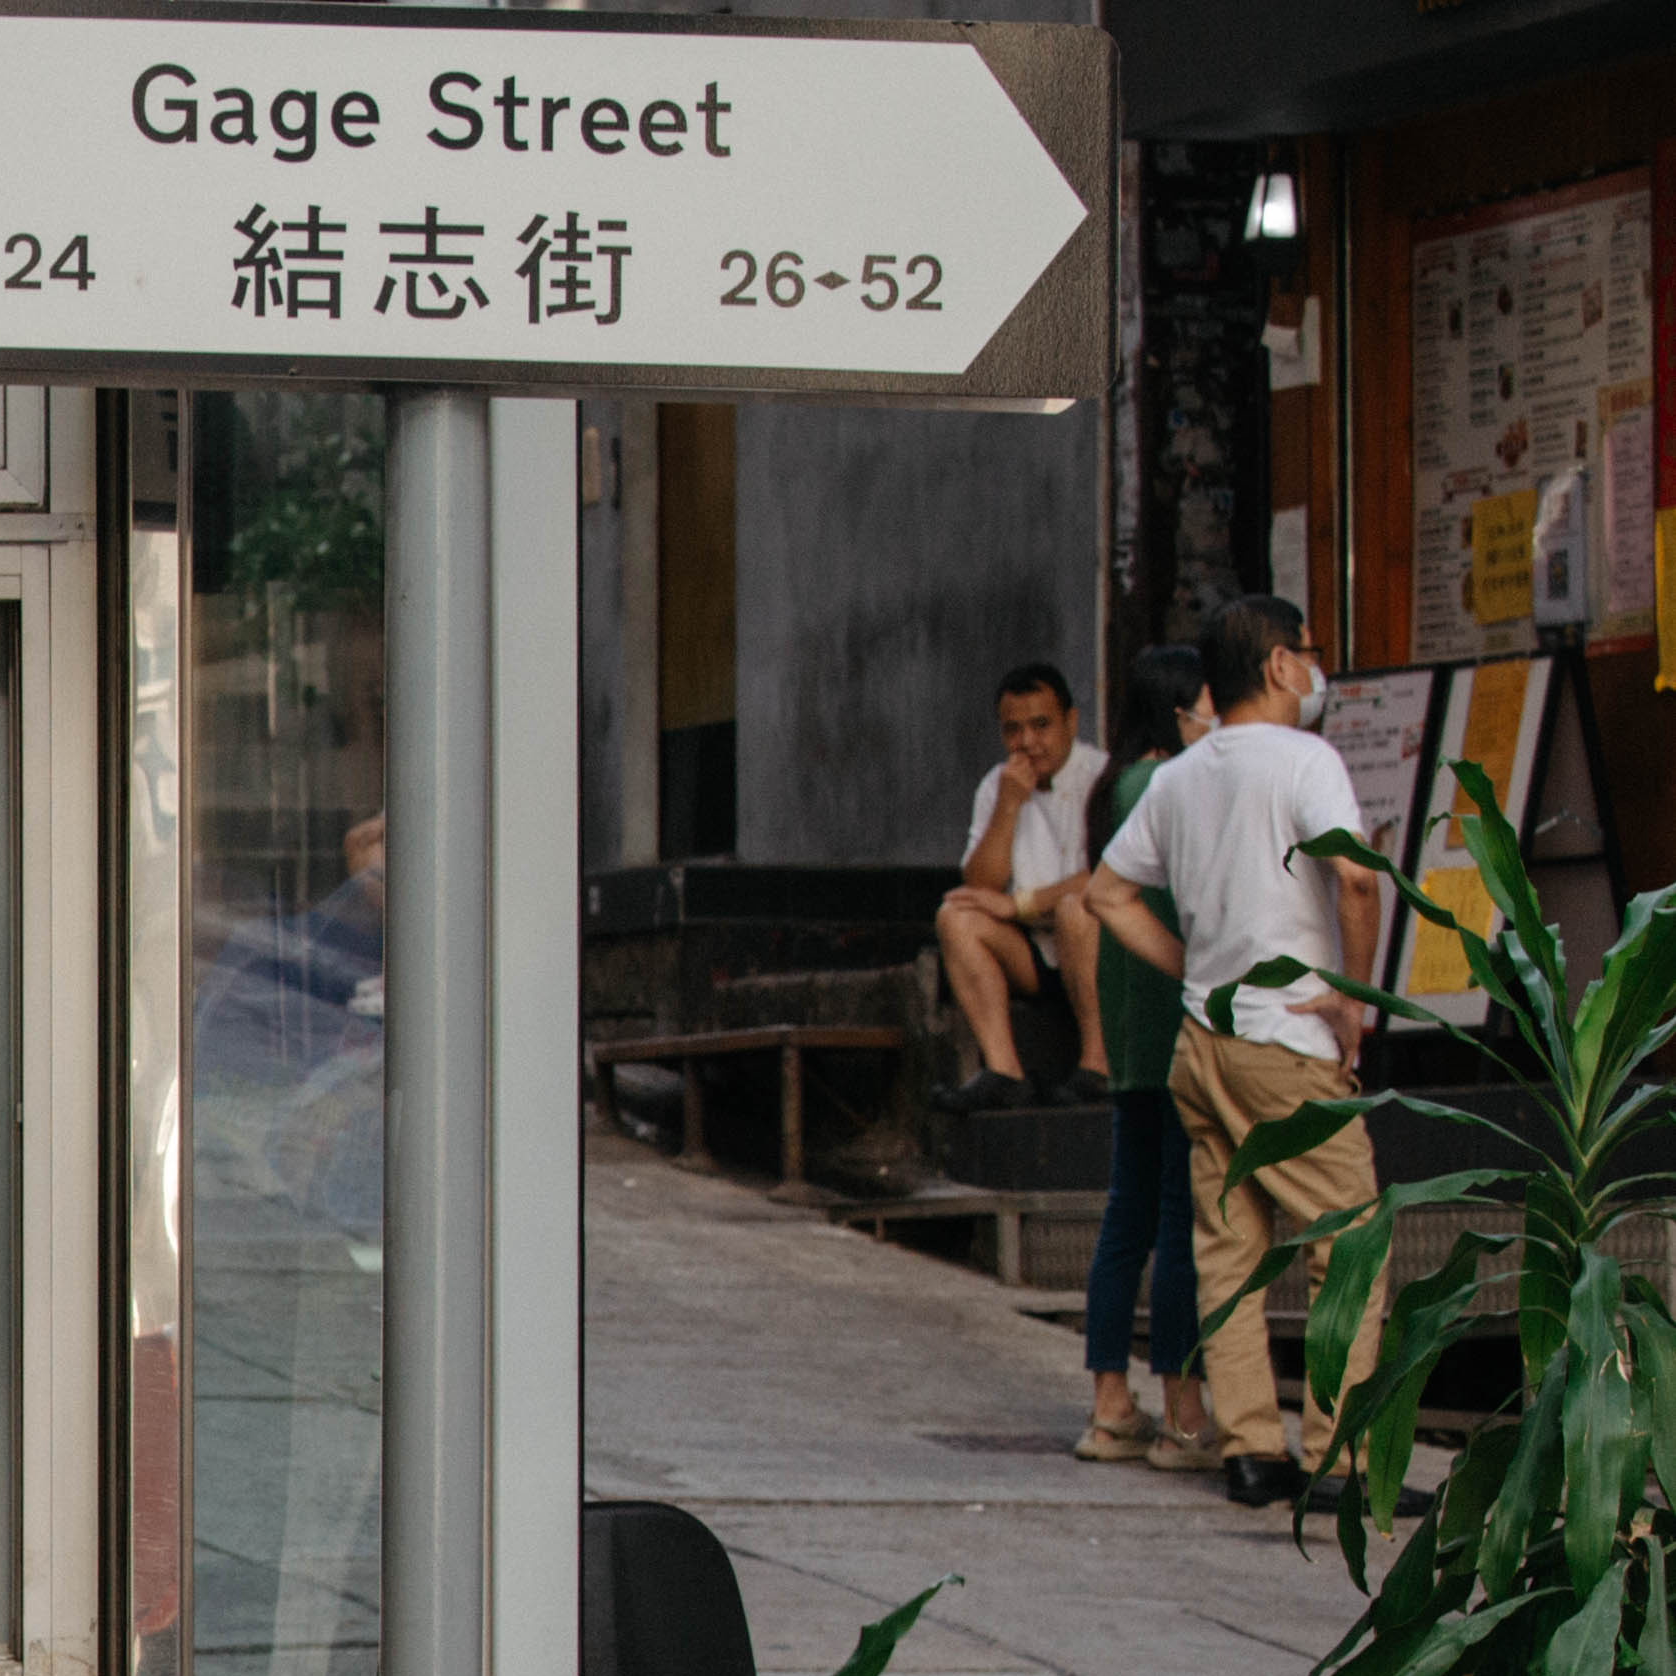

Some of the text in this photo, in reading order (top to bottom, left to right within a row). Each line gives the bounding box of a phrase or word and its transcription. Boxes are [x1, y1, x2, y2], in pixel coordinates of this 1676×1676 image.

[133, 64, 732, 162] Gage Street
[232, 204, 632, 325] 結志街
